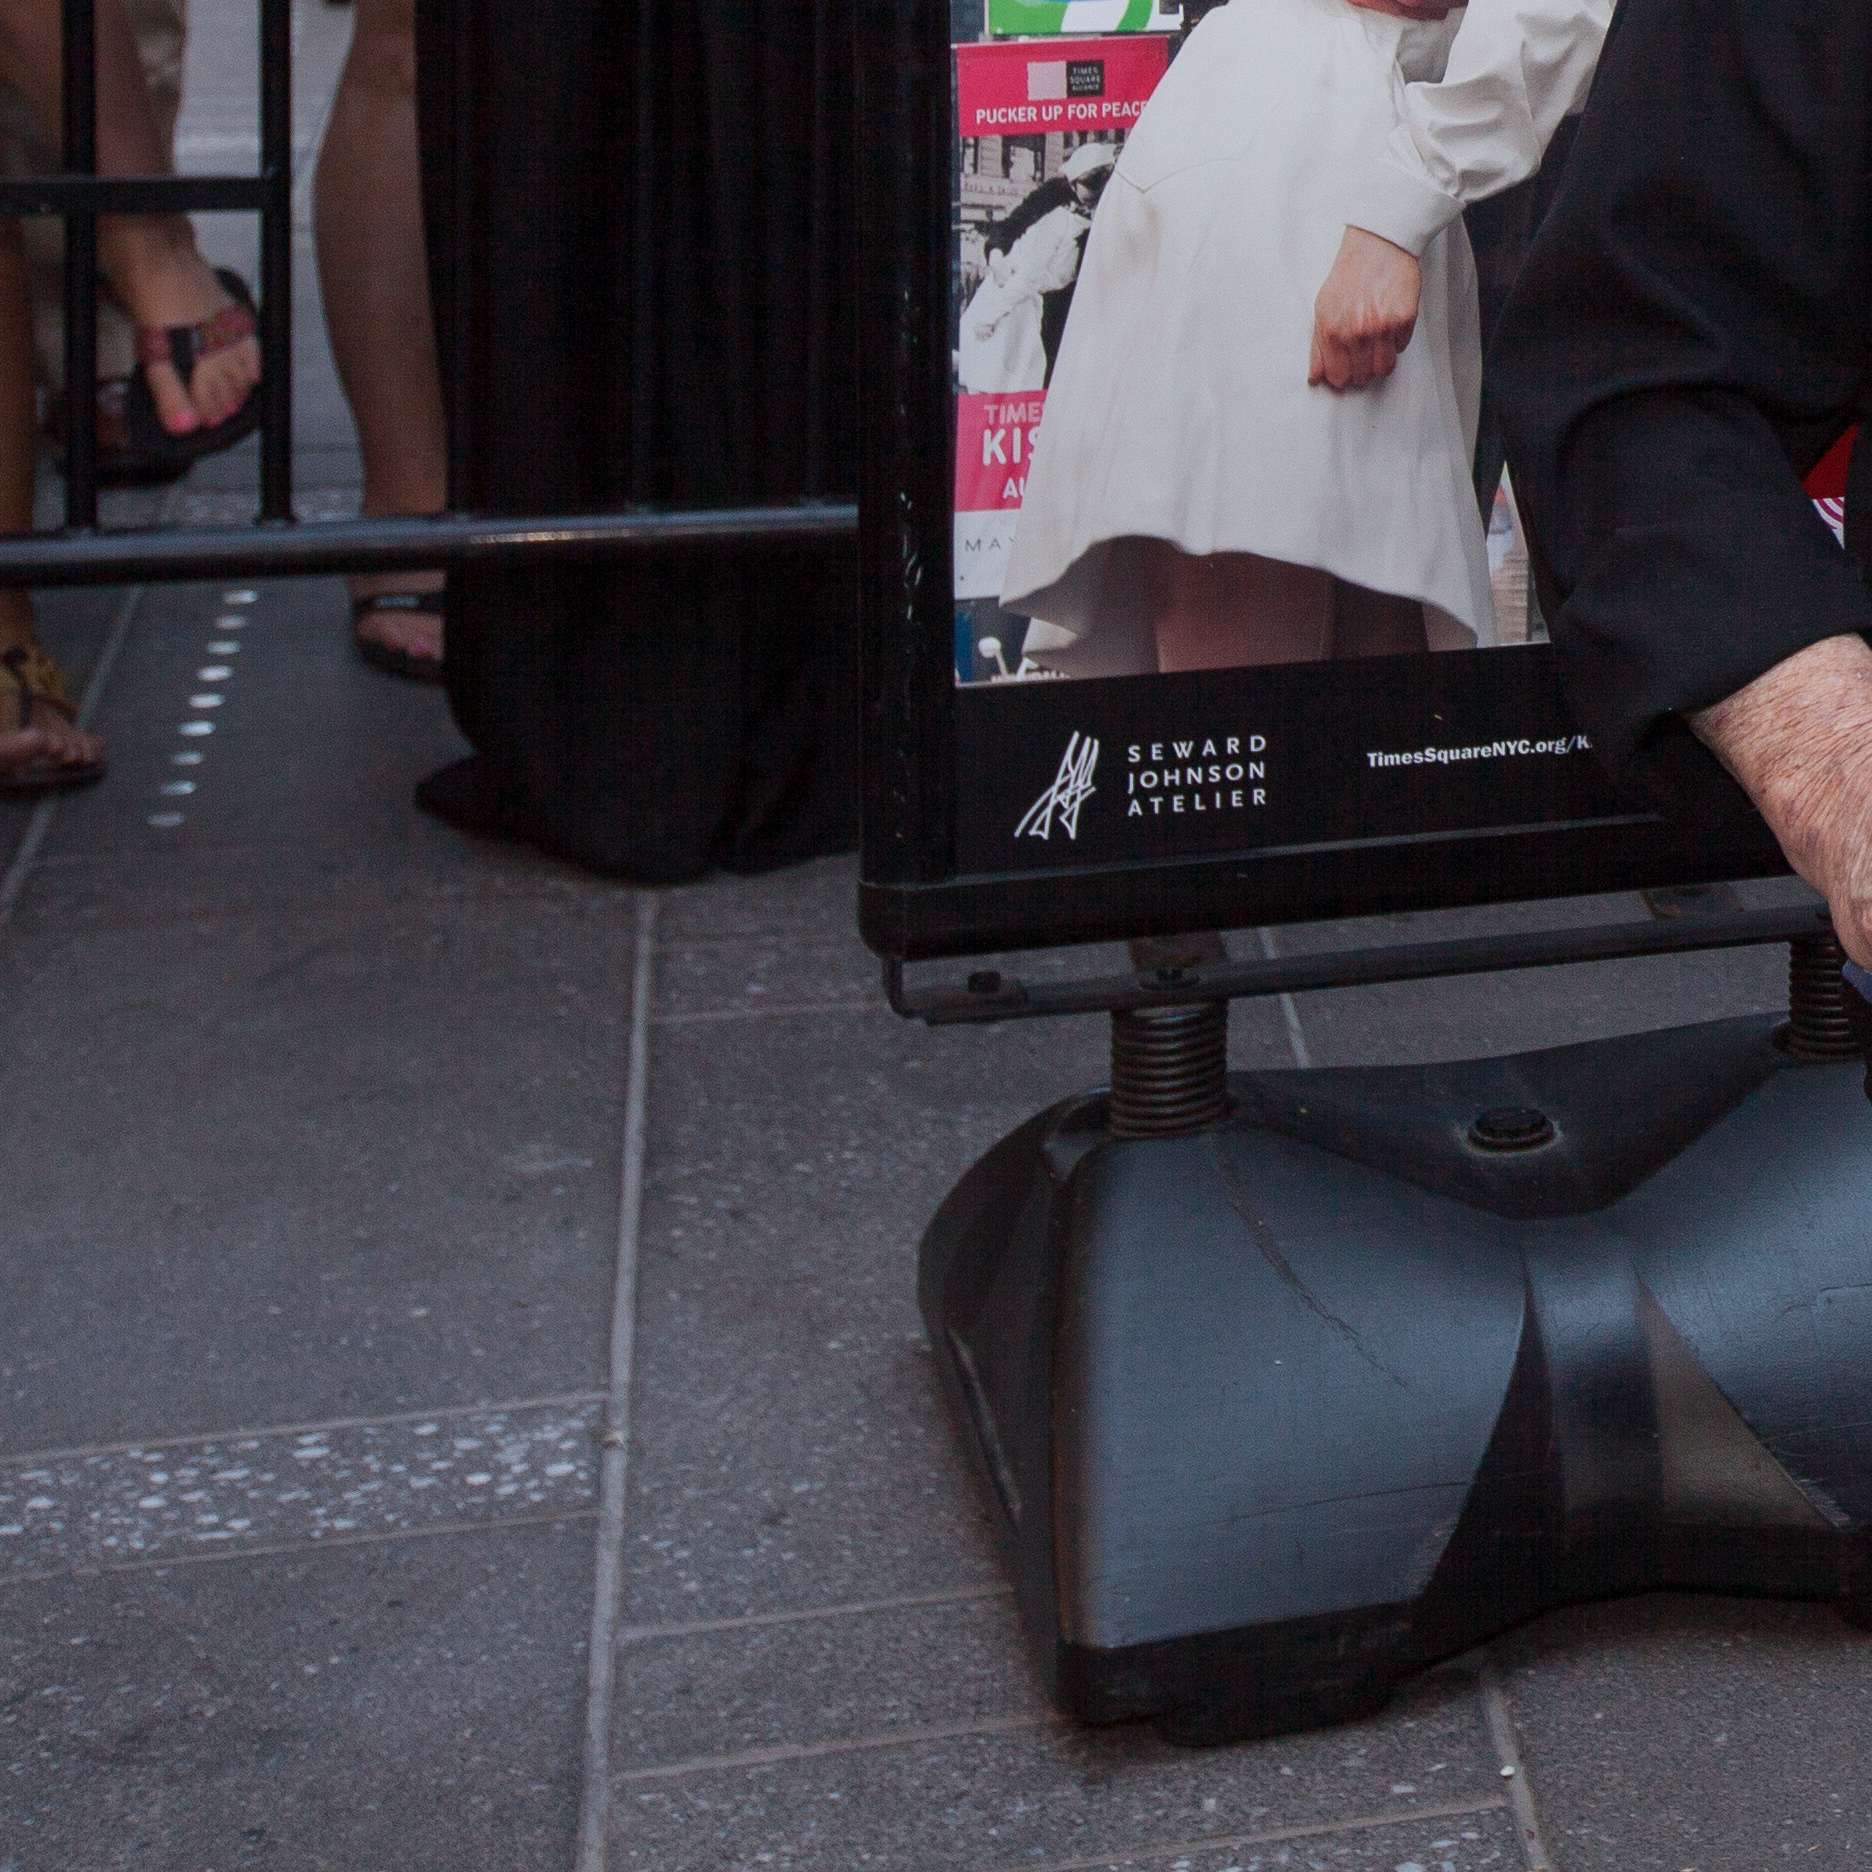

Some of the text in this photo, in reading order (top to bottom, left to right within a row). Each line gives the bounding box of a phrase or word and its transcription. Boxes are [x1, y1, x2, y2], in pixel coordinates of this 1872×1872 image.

[1073, 66, 1098, 75] TIMES
[976, 107, 1037, 124] PUCKER
[1042, 106, 1063, 121] UP
[1067, 103, 1098, 119] FOR
[984, 403, 1043, 424] TIME
[964, 536, 1016, 552] MA
[1127, 734, 1267, 764] SEWARD
[1366, 734, 1593, 768] TimesSquareNYC.org/K
[1127, 761, 1266, 795] JOHNSON
[1127, 788, 1267, 818] ATELIER
